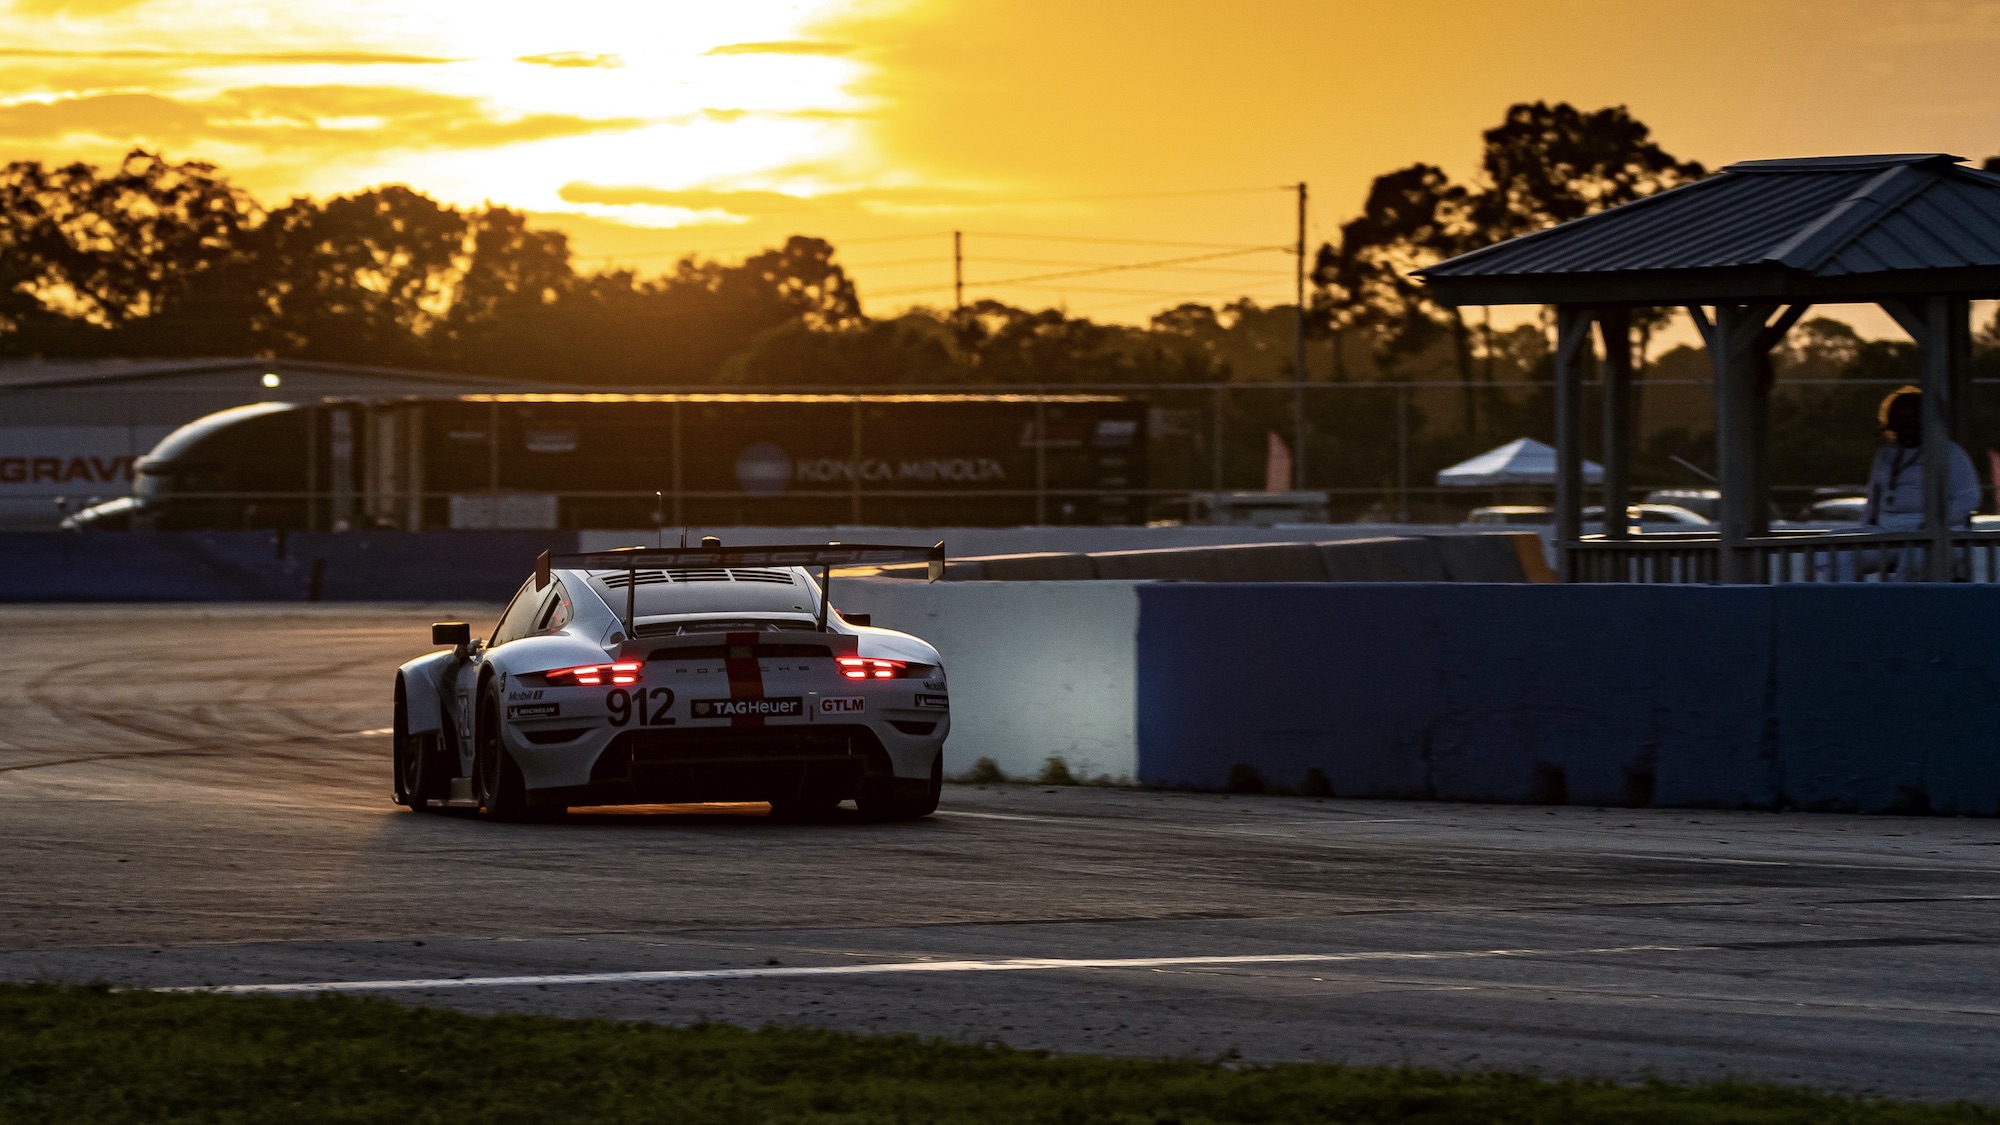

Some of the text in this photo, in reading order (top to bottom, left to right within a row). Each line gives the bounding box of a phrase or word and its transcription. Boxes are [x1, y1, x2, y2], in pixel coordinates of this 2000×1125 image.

[797, 458, 1006, 481] KONCA MINOLTA
[584, 550, 904, 567] PORSCHE
[676, 666, 810, 674] PORCHE
[508, 691, 533, 700] Mobil
[519, 707, 556, 715] MICHELIN
[606, 687, 676, 727] 912
[821, 699, 864, 712] GTLM
